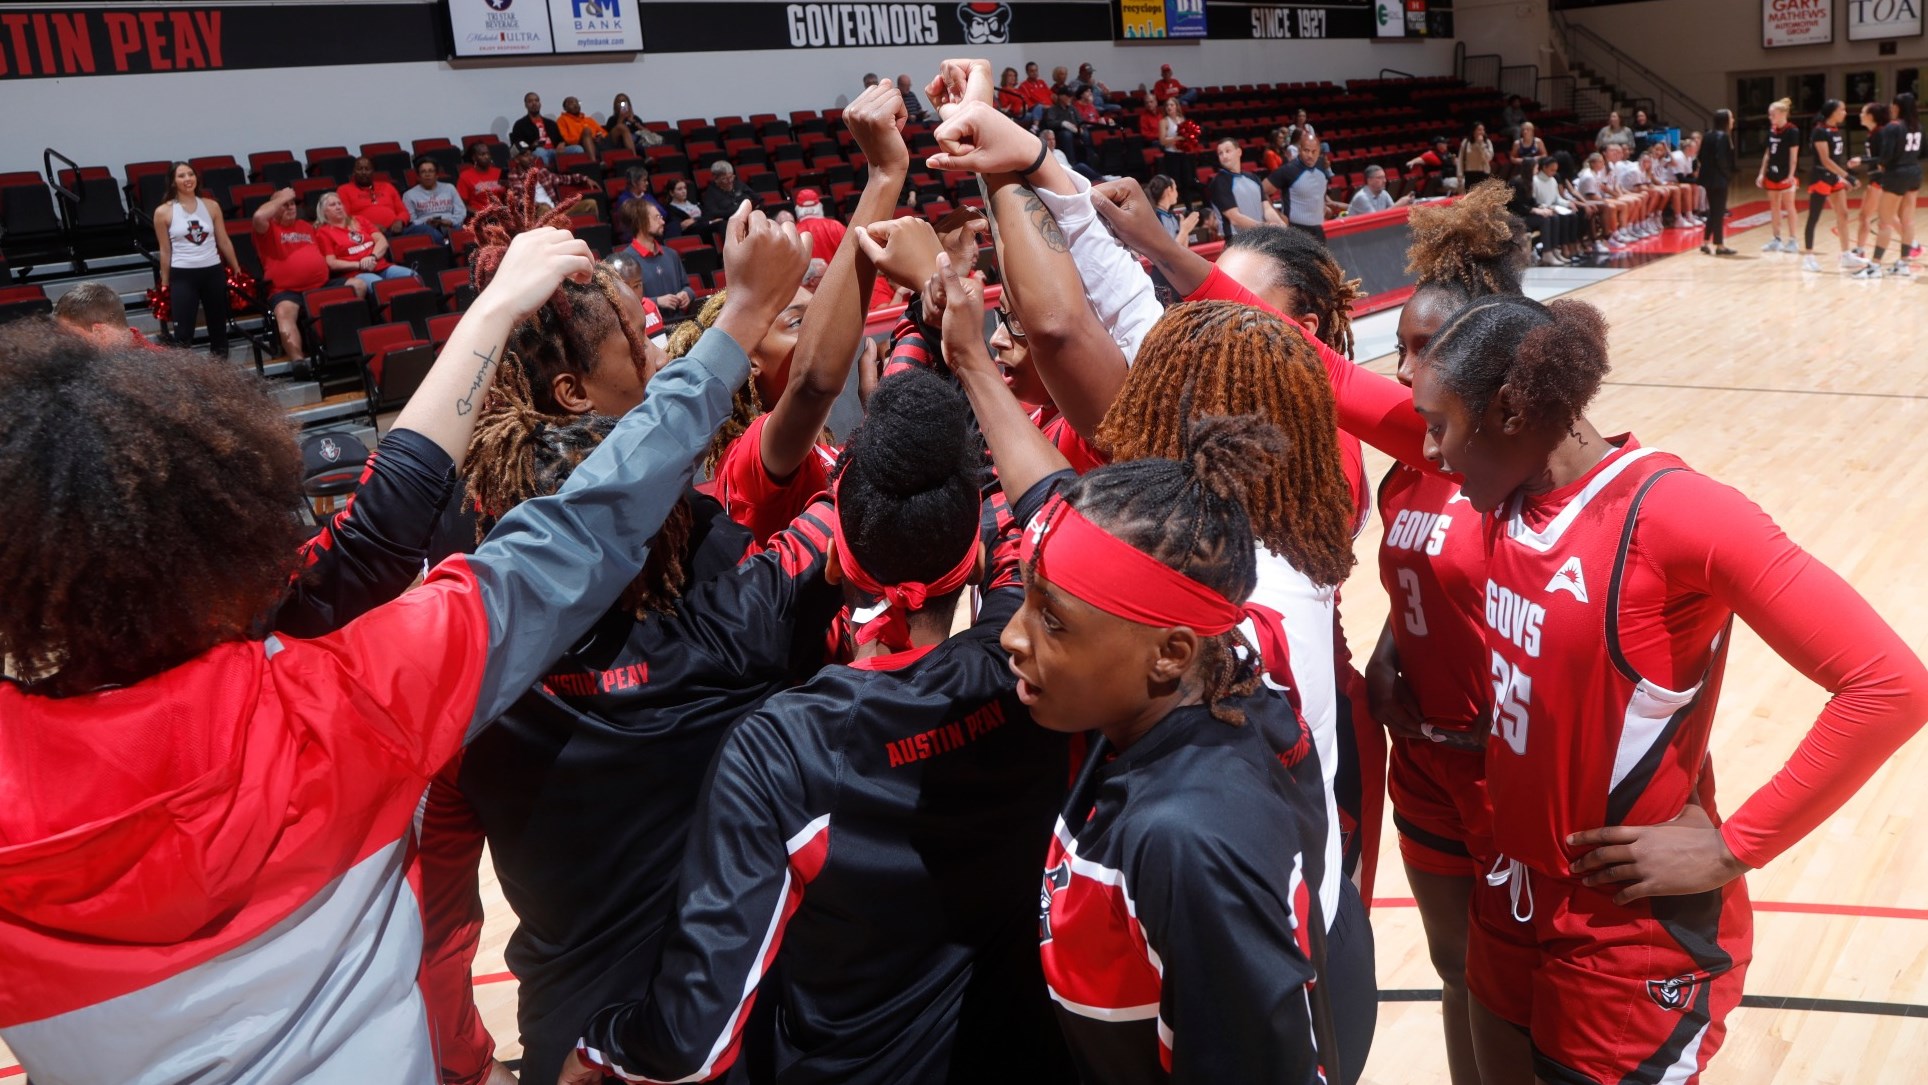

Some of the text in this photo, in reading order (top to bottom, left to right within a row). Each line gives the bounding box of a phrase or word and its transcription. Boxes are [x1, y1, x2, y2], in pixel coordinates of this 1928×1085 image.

[1123, 3, 1163, 14] recyclops
[1251, 8, 1326, 38] SINCE 1927
[1768, 9, 1826, 22] MATHEWS
[1850, 0, 1917, 23] TOA
[506, 31, 540, 41] ULTRA
[574, 20, 622, 30] BANK
[786, 4, 939, 47] GOVERNORS
[0, 10, 223, 76] TIN PEAY
[1905, 132, 1922, 152] 33
[1386, 508, 1453, 556] GOVS
[1397, 567, 1428, 637] 3
[1485, 577, 1547, 659] GOVS
[601, 662, 649, 693] PEAY
[1491, 647, 1533, 757] 25
[885, 699, 1007, 769] AUSTIN PEAY
